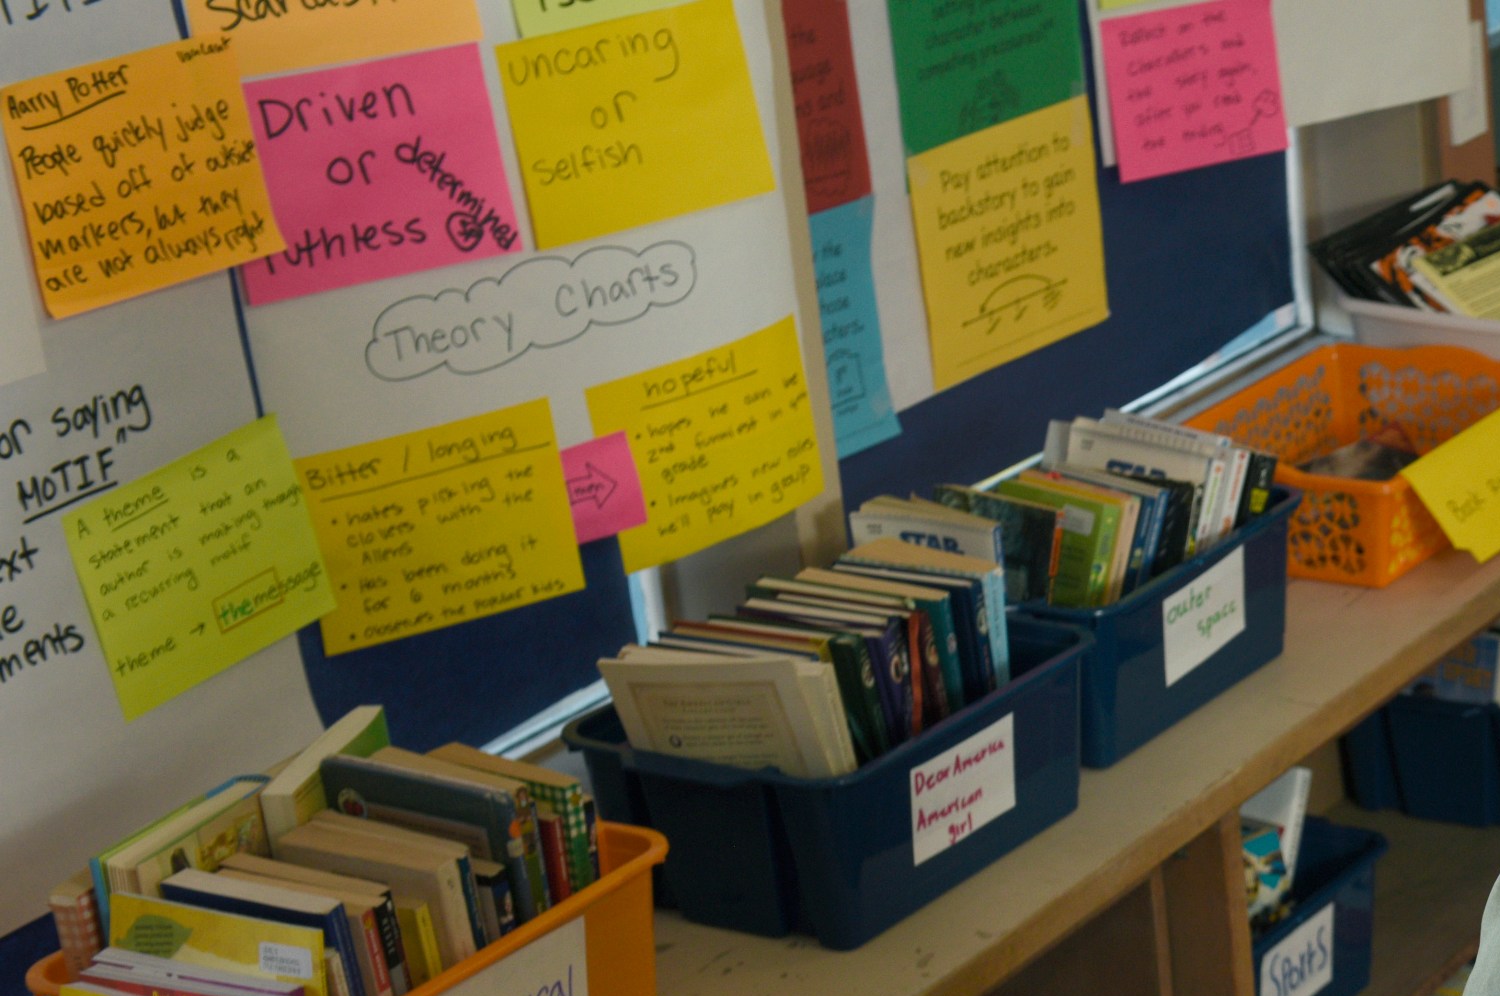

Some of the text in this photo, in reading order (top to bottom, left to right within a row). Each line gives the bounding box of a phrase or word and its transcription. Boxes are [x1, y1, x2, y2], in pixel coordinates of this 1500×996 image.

[506, 28, 681, 86] Uncaring
[7, 64, 129, 119] Harry Potter
[257, 80, 416, 140] Driven
[590, 89, 637, 131] or
[18, 99, 229, 180] People quickly judge
[1052, 134, 1071, 152] to
[33, 180, 106, 225] based
[117, 164, 152, 198] off
[154, 204, 187, 231] but
[198, 187, 242, 216] they
[325, 136, 518, 252] or determined
[1021, 179, 1040, 197] to
[45, 264, 88, 292] are
[98, 249, 133, 278] not
[143, 226, 221, 264] always
[384, 262, 680, 363] Theory Charts
[51, 384, 152, 439] saying
[305, 457, 382, 491] Bitter
[427, 426, 519, 463] longing
[505, 464, 534, 482] the
[103, 484, 166, 527] theme
[190, 466, 207, 481] is
[504, 489, 534, 508] the
[88, 514, 180, 571] statement
[200, 492, 232, 517] that
[99, 561, 151, 598] author
[168, 547, 184, 564] is
[199, 507, 262, 546] making
[209, 538, 252, 568] motif
[0, 536, 38, 583] xt
[115, 634, 177, 679] theme
[913, 766, 952, 797] Dear
